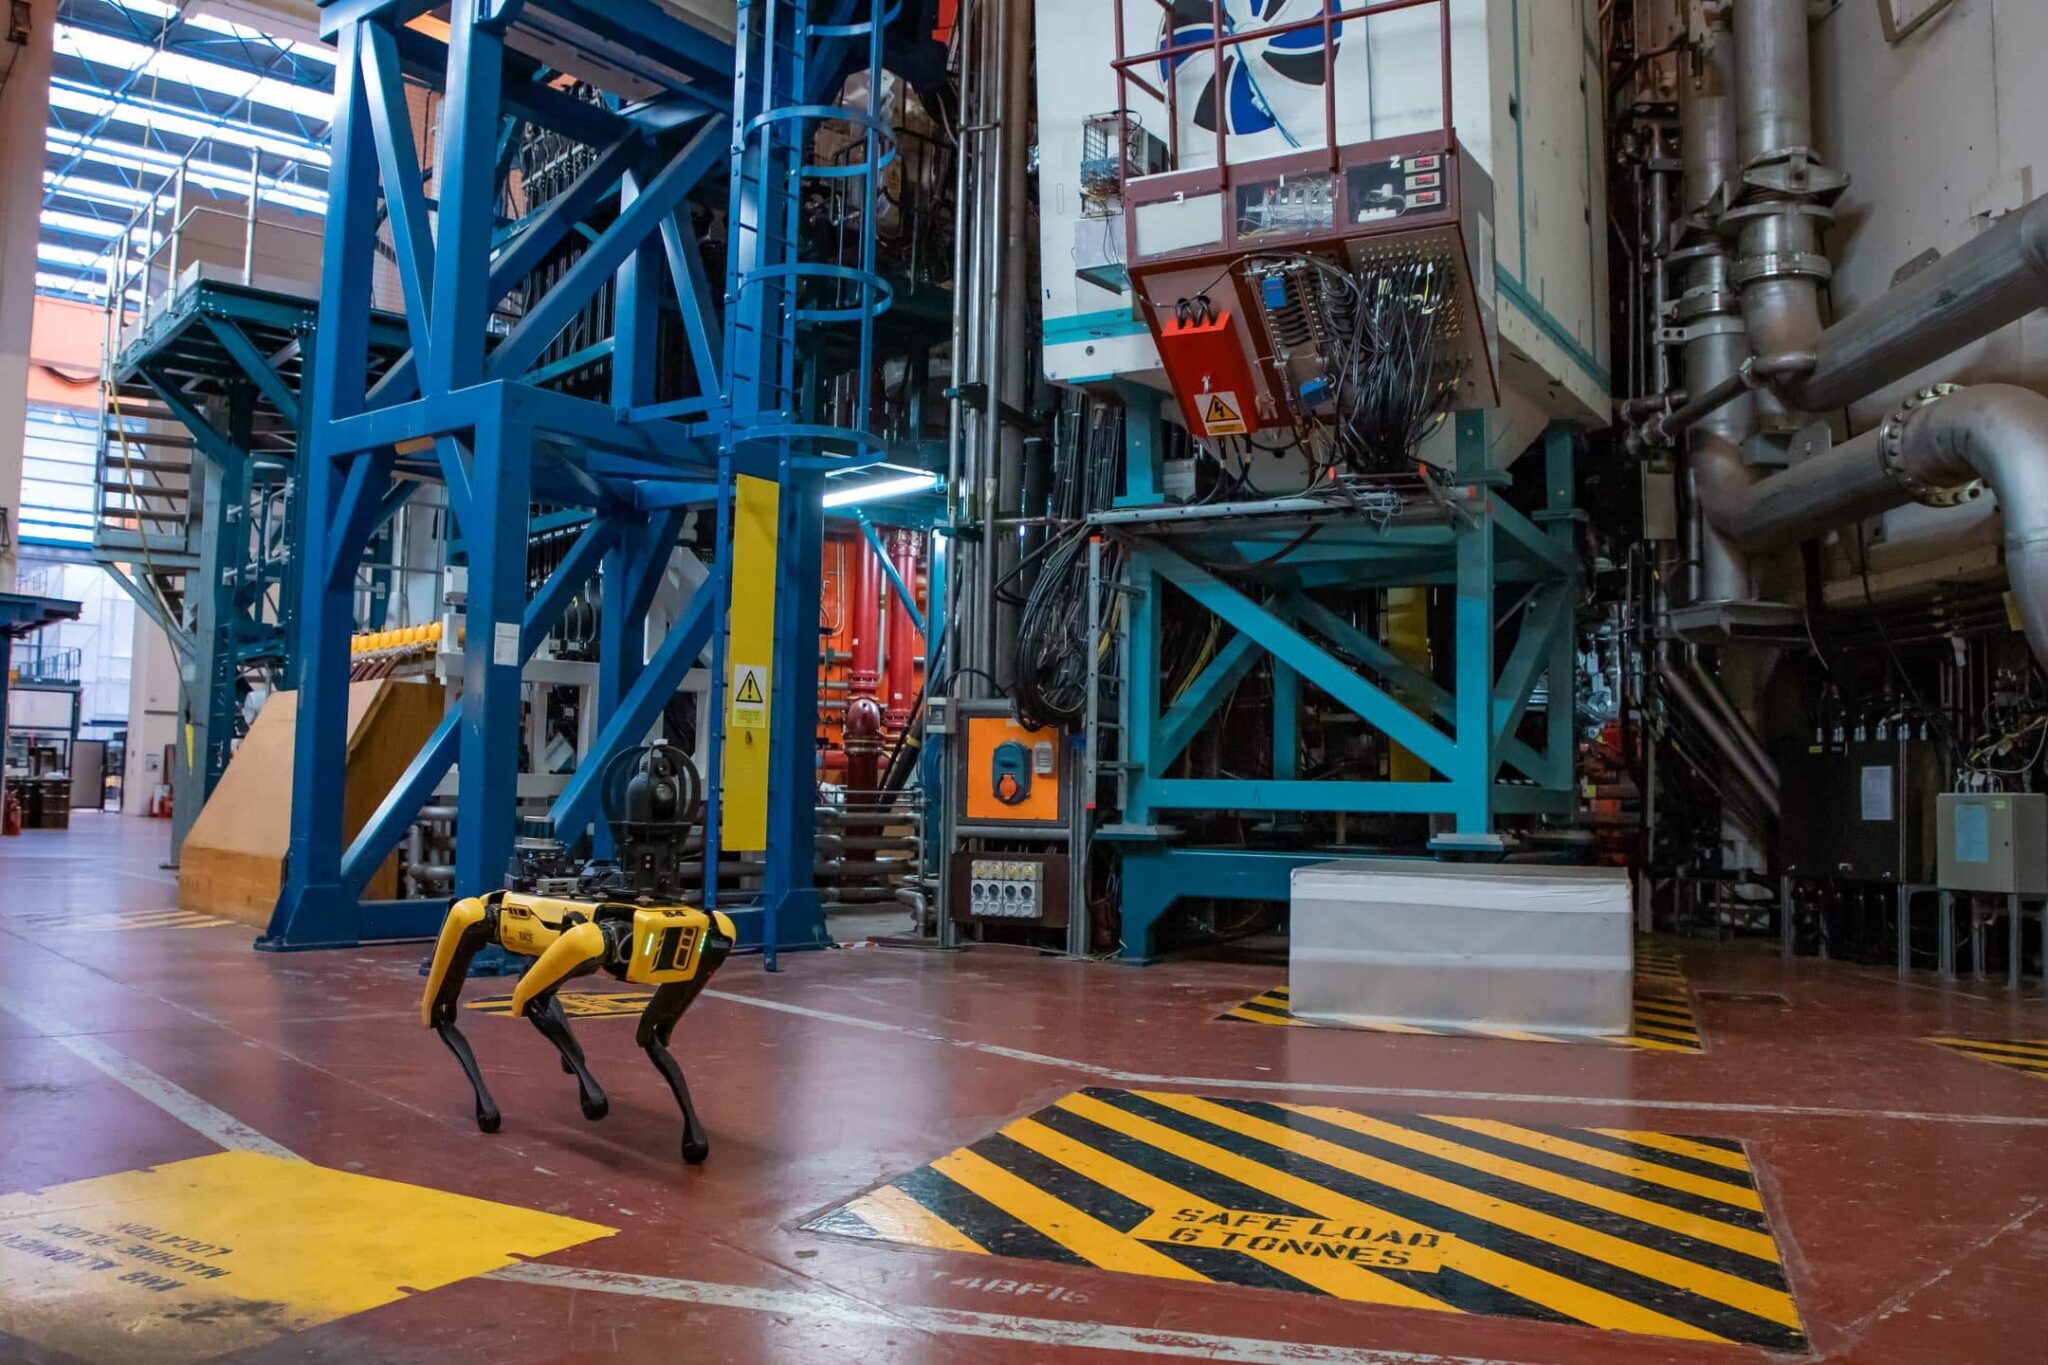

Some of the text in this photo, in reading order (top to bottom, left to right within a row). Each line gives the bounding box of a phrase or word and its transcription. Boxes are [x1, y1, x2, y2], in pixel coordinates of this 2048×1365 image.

[114, 1222, 233, 1258] LOCATION
[1168, 1227, 1413, 1266] 6 TONNES
[1171, 1208, 1441, 1249] SAFE LOAD
[37, 1223, 232, 1280] MACHINE BLOCK
